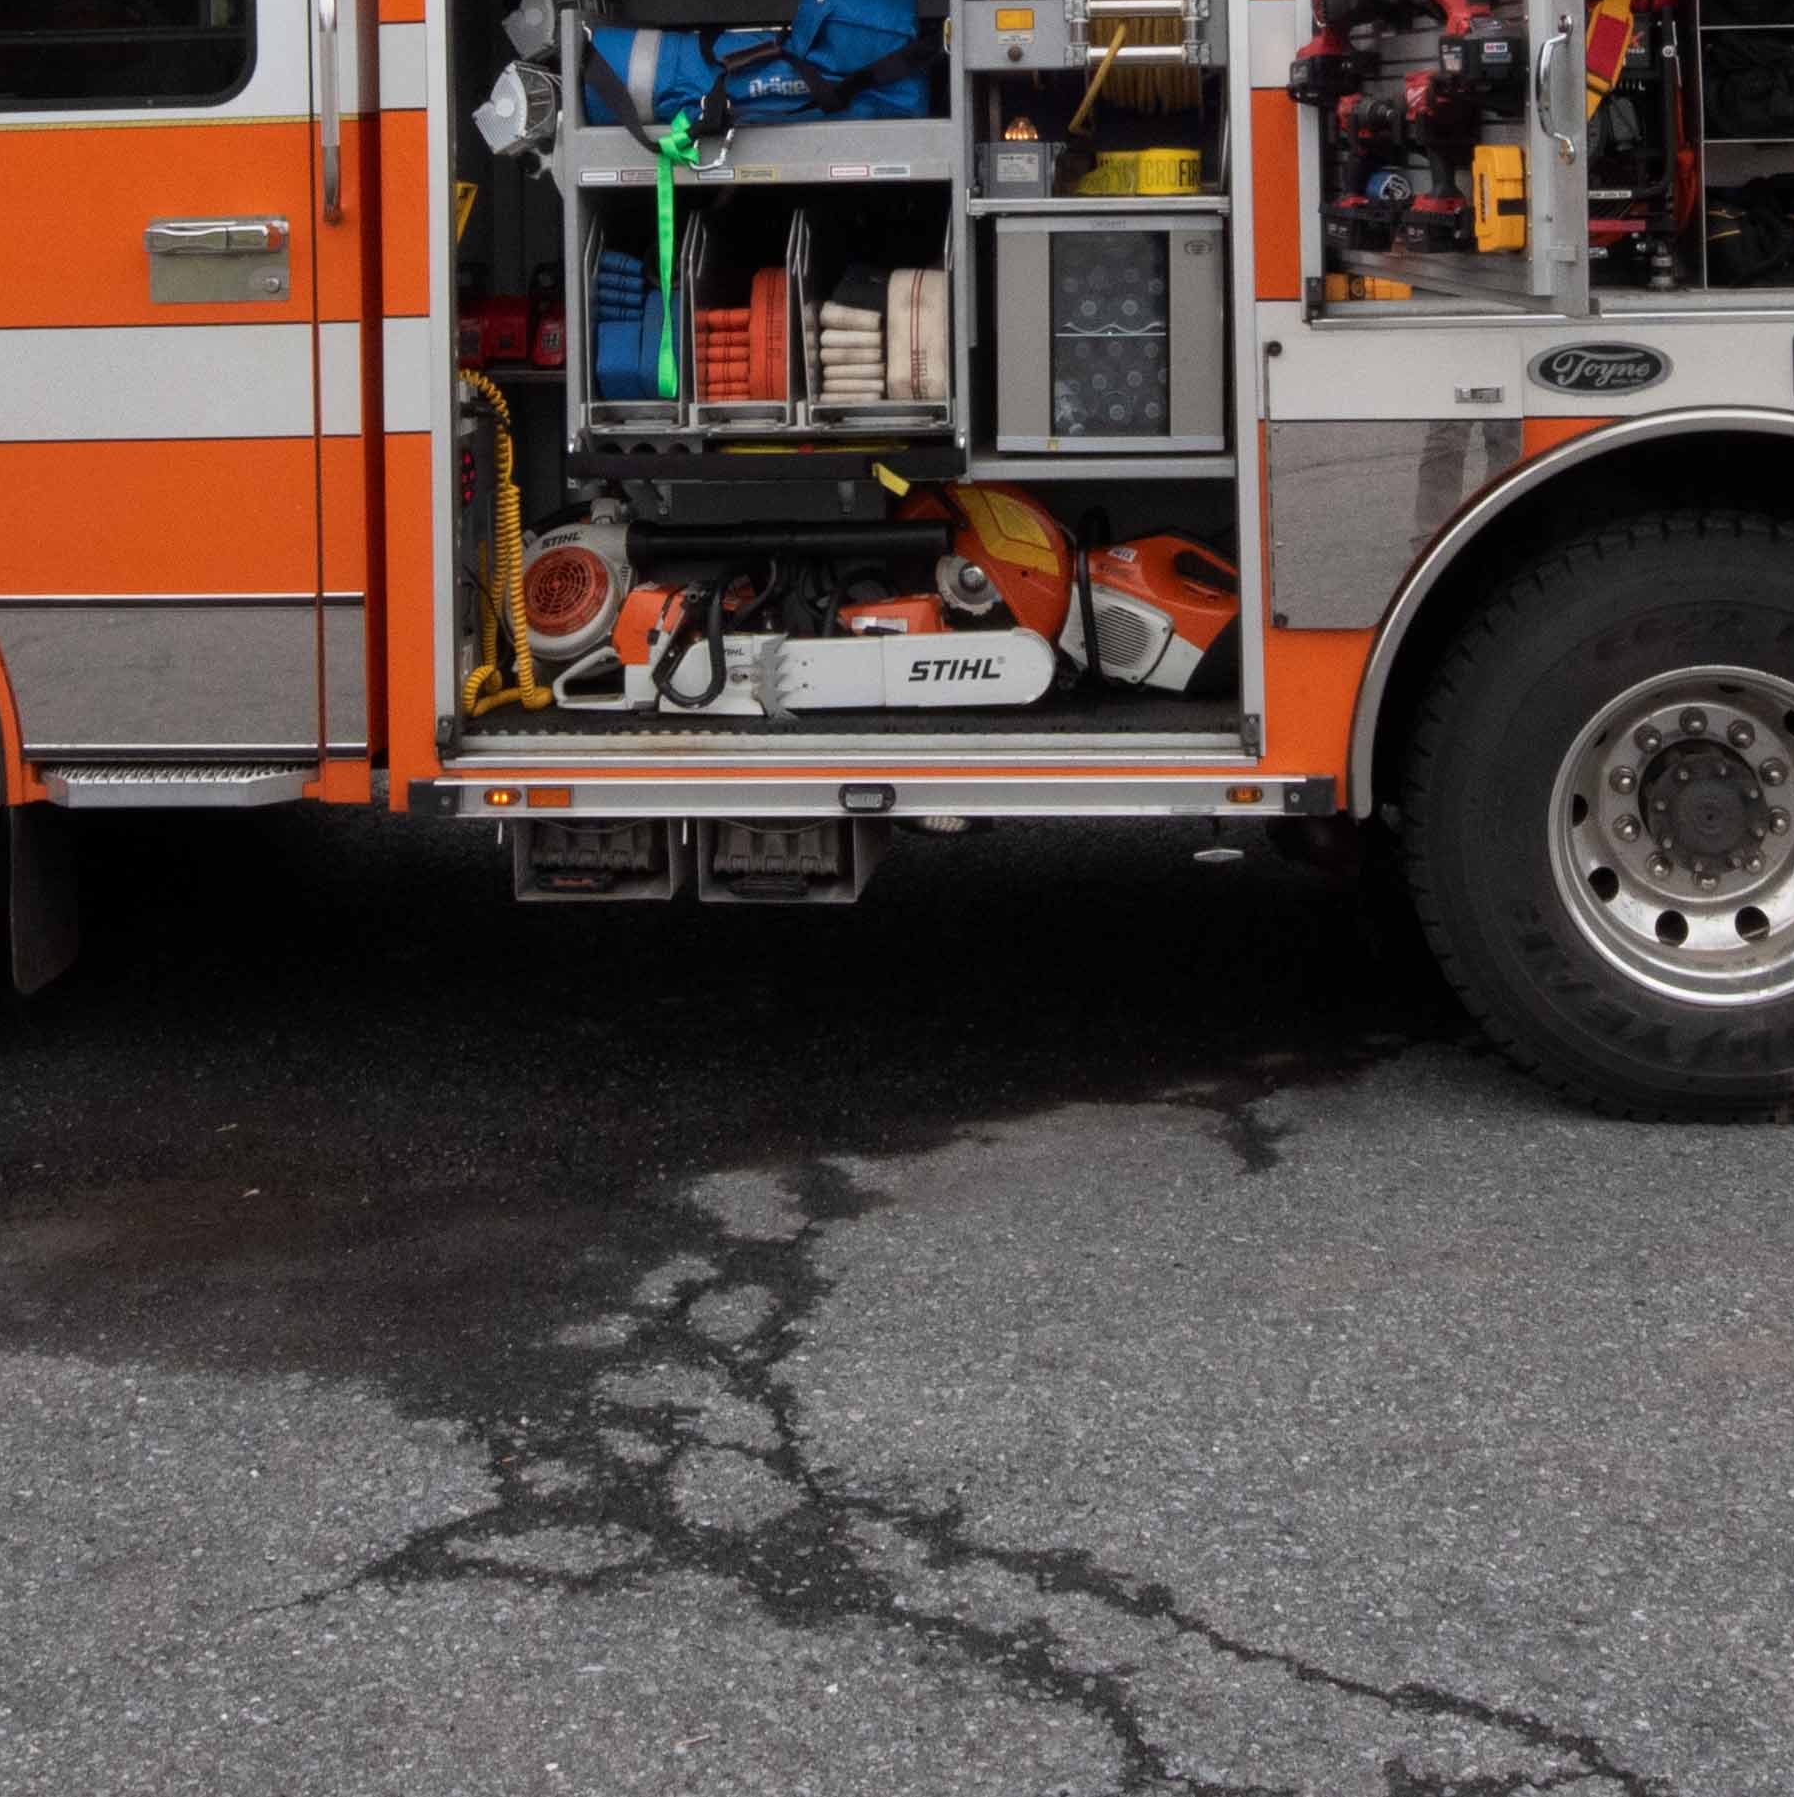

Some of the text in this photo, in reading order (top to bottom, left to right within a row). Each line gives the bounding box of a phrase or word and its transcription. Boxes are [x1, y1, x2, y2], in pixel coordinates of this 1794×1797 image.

[749, 75, 812, 99] Dräge
[1551, 349, 1650, 387] Toyne
[541, 531, 583, 550] STIHL
[723, 646, 745, 658] TIHL
[908, 656, 1002, 683] STIHL
